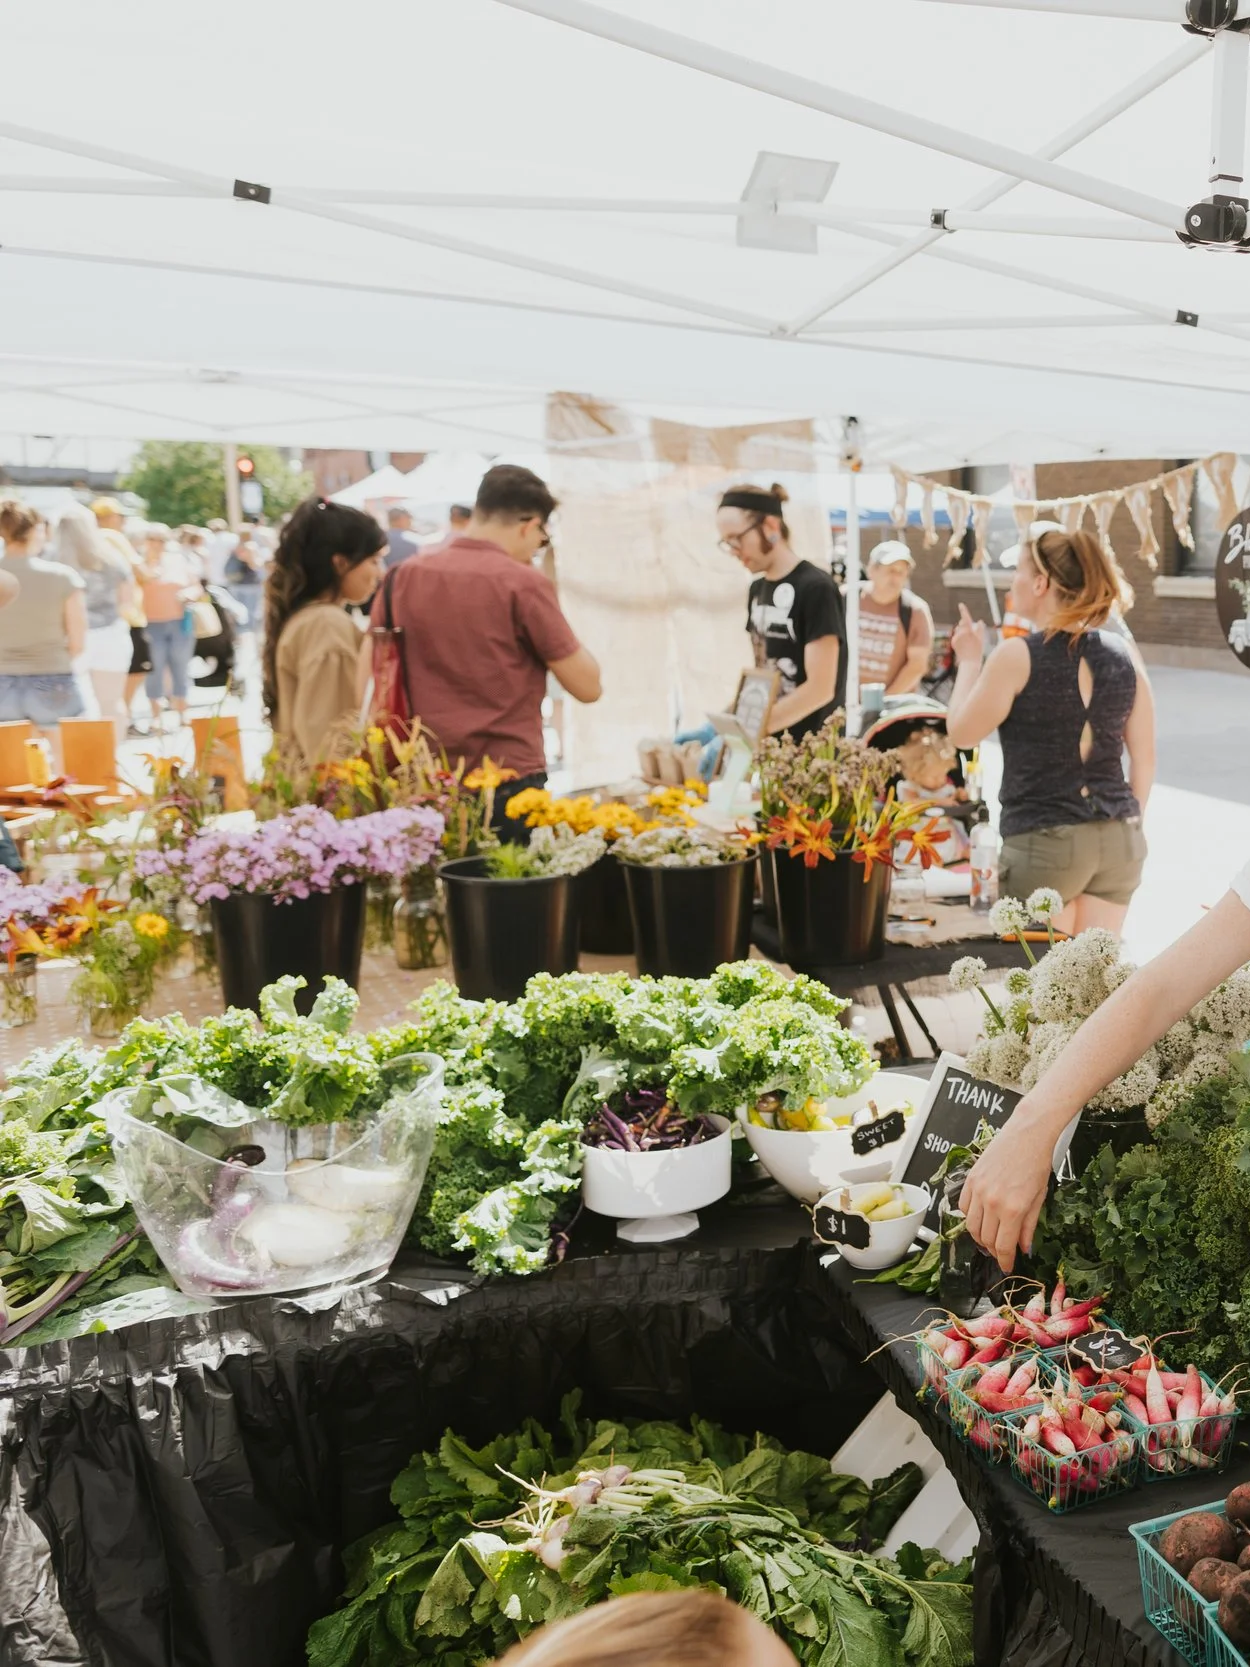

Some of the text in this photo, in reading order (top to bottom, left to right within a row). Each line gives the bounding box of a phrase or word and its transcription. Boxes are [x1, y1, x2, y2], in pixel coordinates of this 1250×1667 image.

[946, 1077, 1004, 1116] THANK
[857, 1118, 895, 1141] SWEET
[827, 1214, 847, 1236] $1
